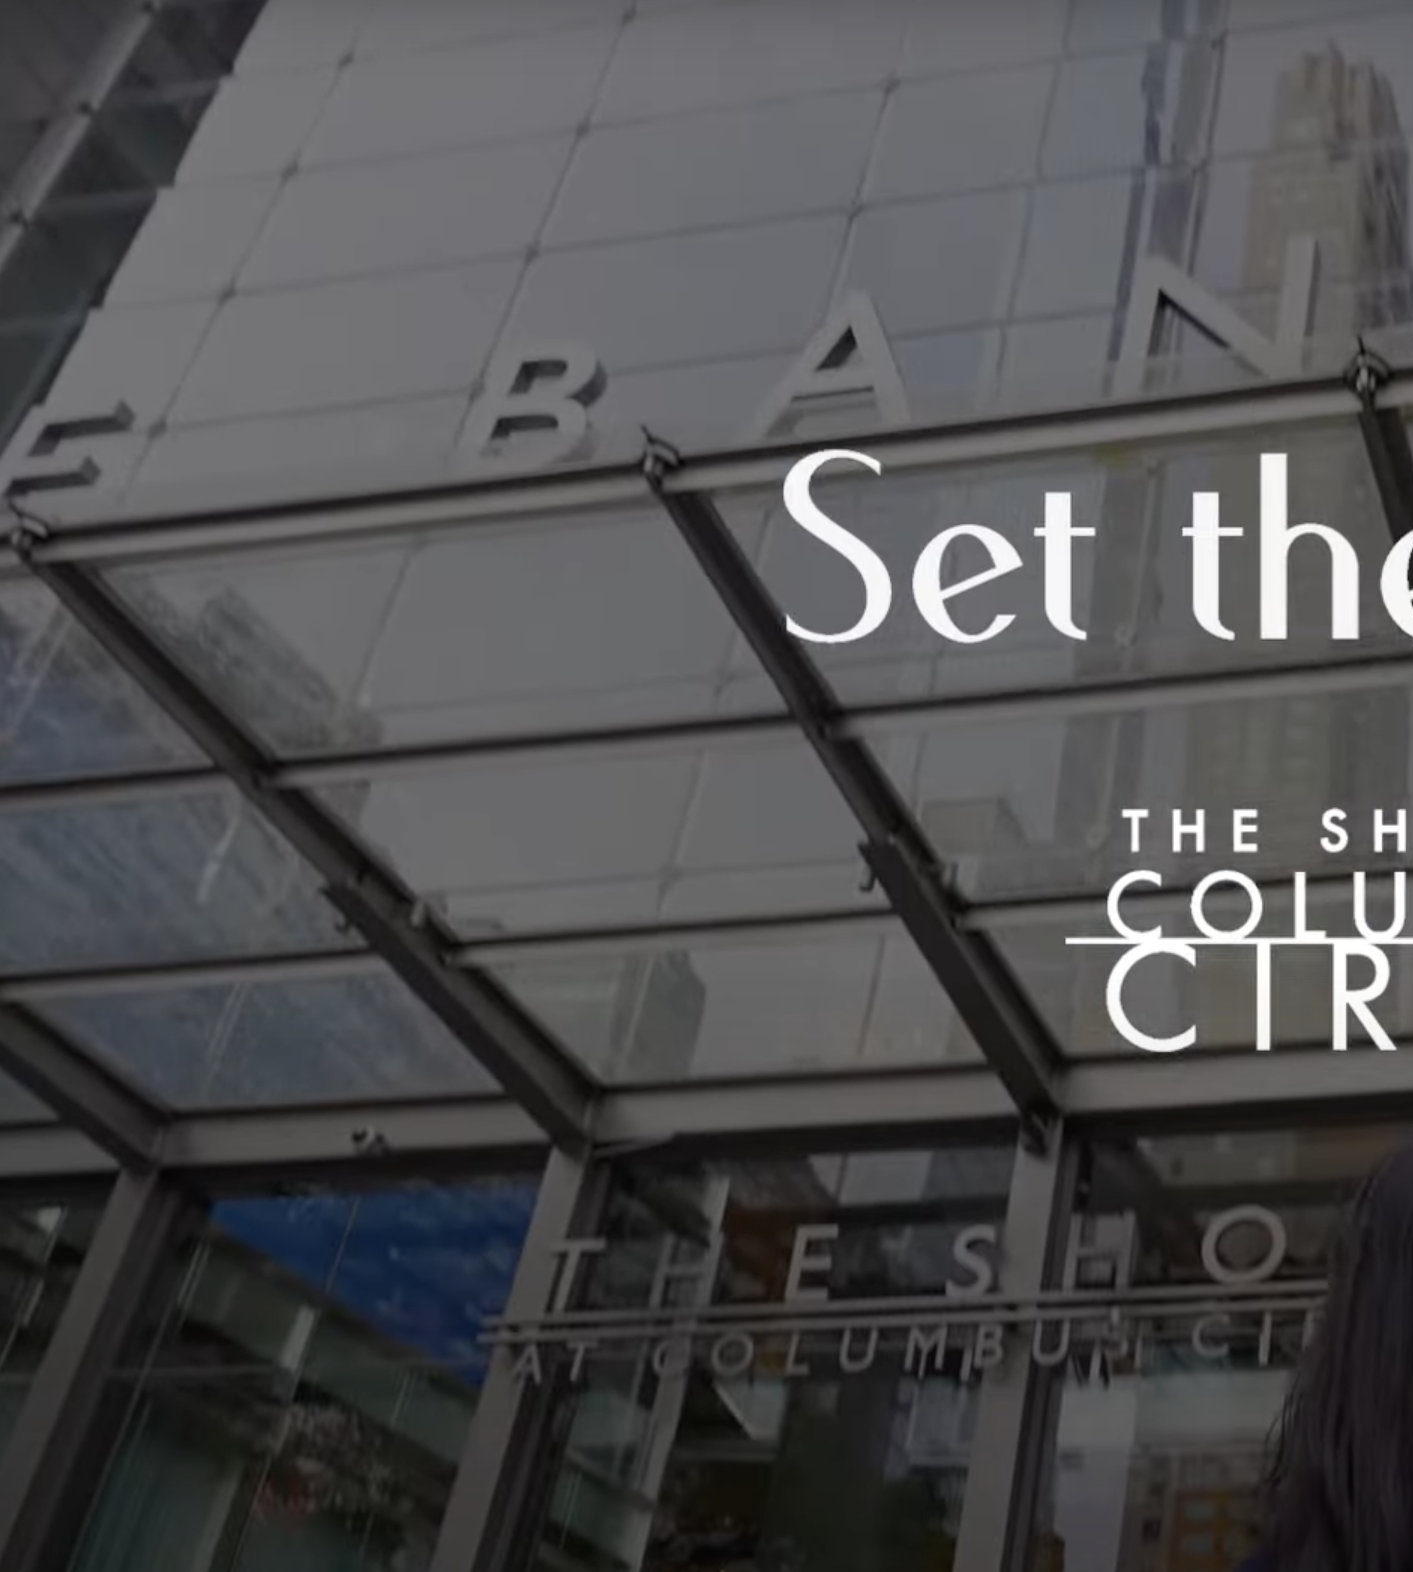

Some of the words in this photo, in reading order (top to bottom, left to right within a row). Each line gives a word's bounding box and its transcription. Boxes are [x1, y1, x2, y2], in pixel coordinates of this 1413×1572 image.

[548, 1222, 840, 1314] THE
[944, 1204, 1289, 1300] SHO
[508, 1337, 599, 1385] AT
